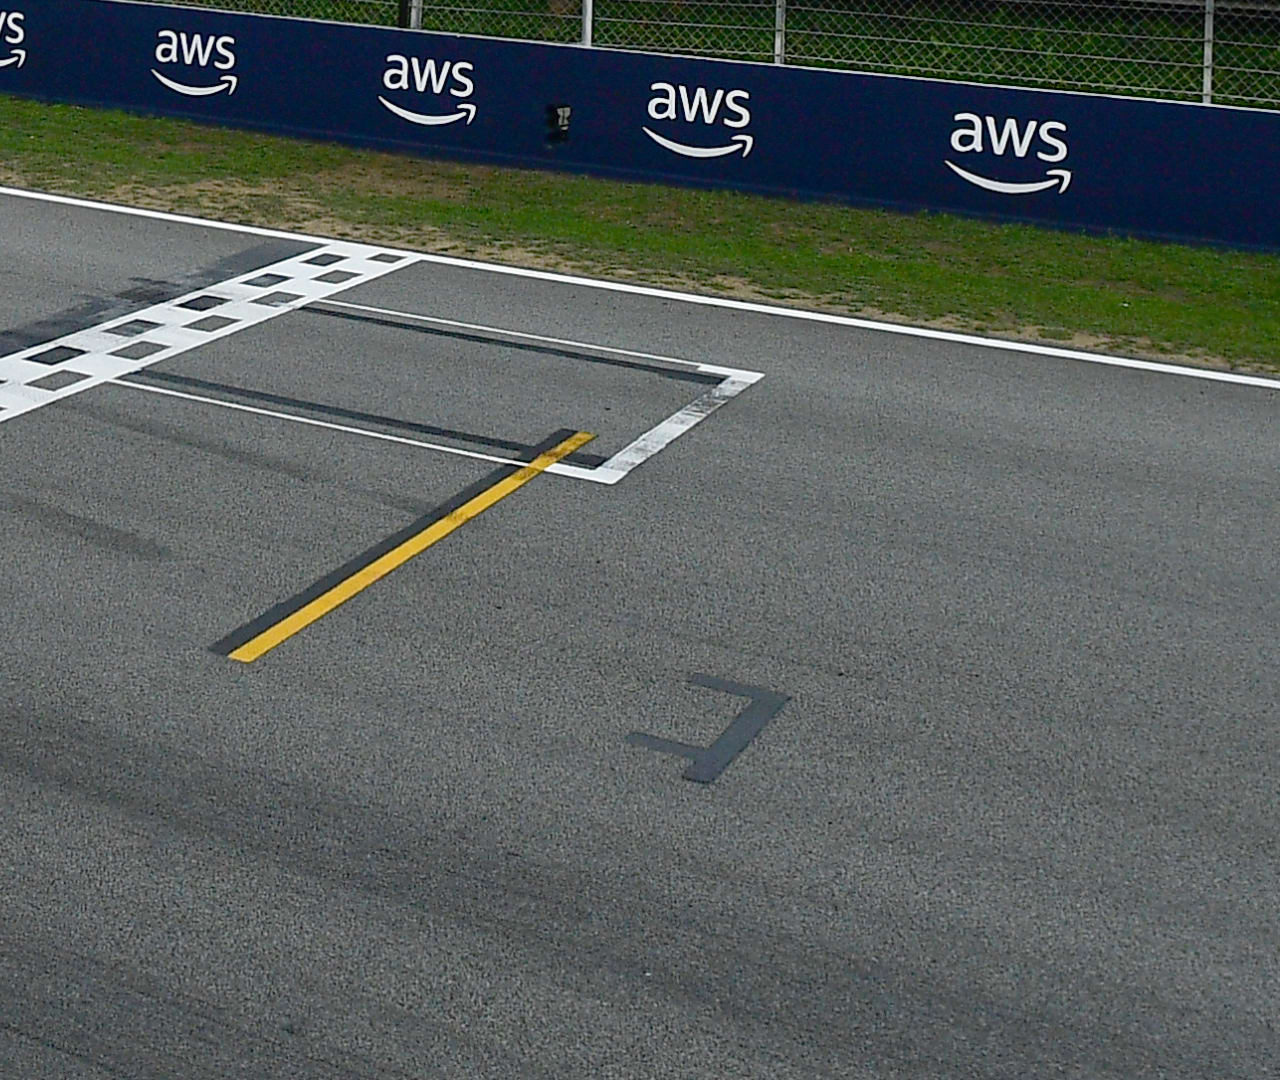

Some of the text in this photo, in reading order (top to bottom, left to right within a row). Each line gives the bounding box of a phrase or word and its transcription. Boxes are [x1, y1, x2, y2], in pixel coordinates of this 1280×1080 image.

[155, 30, 236, 70] aws
[383, 55, 474, 98] aws
[647, 83, 750, 128] aws
[950, 113, 1068, 163] aws
